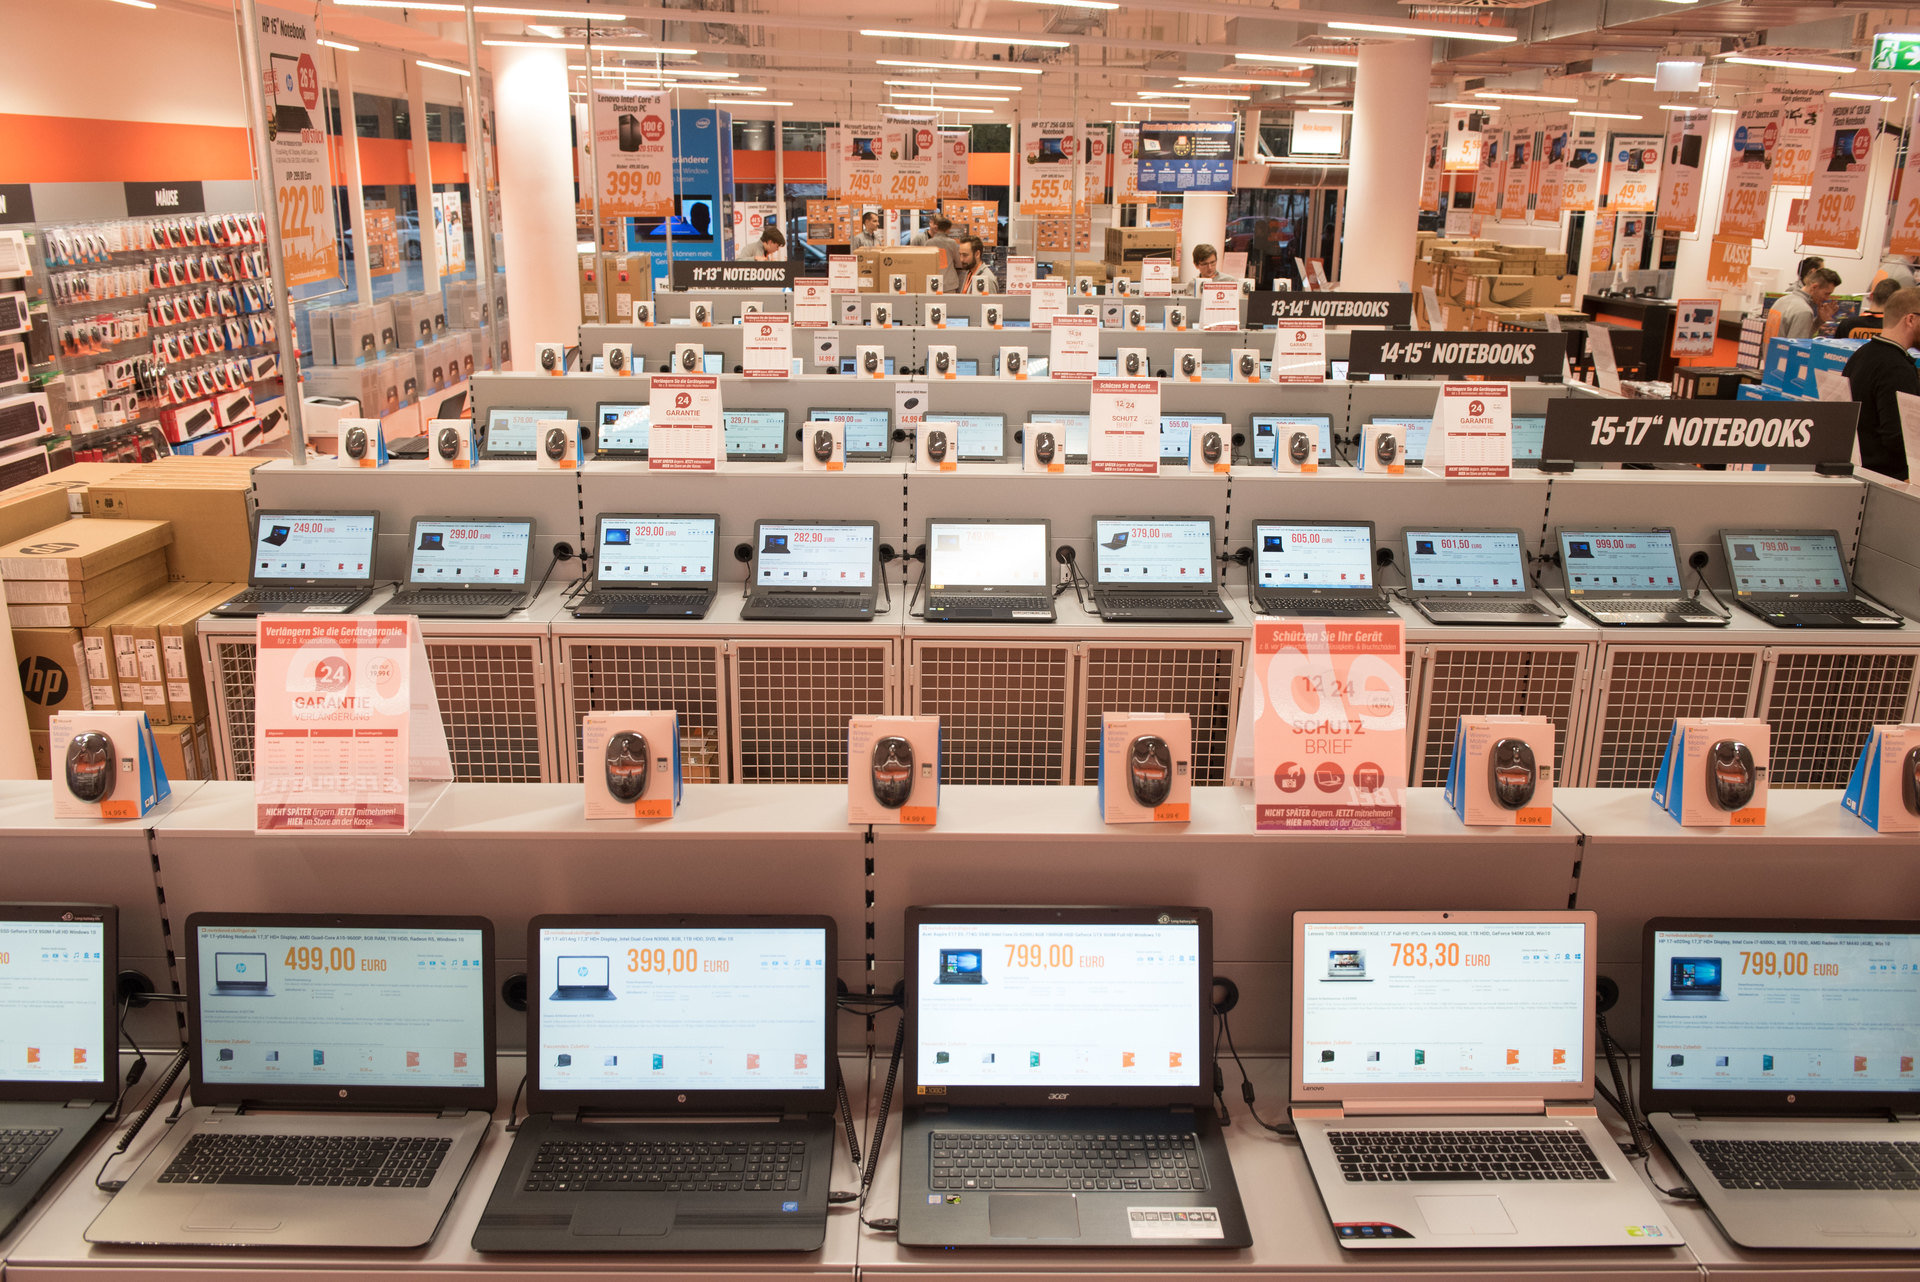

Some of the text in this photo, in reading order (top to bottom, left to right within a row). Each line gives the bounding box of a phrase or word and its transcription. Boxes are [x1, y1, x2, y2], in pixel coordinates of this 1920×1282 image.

[280, 20, 306, 40] Notebook
[598, 94, 620, 103] Lenovo
[613, 104, 647, 112] Desktop PC
[643, 121, 663, 131] 100 €
[1042, 128, 1065, 136] Notebook
[672, 156, 709, 164] eränderer
[155, 189, 179, 207] MÄUSE
[1722, 244, 1750, 264] KASSE
[723, 268, 786, 281] NOTEBOOKS
[1310, 300, 1390, 318] NOTEBOOKS
[1432, 343, 1537, 366] NOTEBOOKS
[677, 396, 689, 404] 24
[1470, 404, 1482, 413] 24
[1663, 417, 1815, 448] NOTEBOOKS
[293, 522, 323, 534] 249,00
[449, 528, 479, 540] 299,00
[635, 526, 664, 537] 329,00
[1131, 527, 1160, 539] 379,00
[794, 532, 823, 543] 282,90
[1291, 533, 1320, 545] 605,00
[1441, 538, 1470, 550] 601,50
[1595, 538, 1624, 550] 999,00
[1760, 541, 1789, 552] 799,00
[266, 626, 402, 638] Verlängern Sie die Gerätegarantie
[1272, 630, 1383, 642] Schützen Sie Ihr Gerät
[320, 665, 346, 683] 24
[1302, 675, 1355, 697] 12 24
[295, 696, 370, 709] GARANTIE
[1292, 719, 1365, 735] SCHUTZ
[1305, 738, 1353, 754] BRIEF
[266, 807, 286, 816] NICHT
[287, 806, 312, 816] SPÄTER
[337, 808, 356, 816] JETZT
[1264, 809, 1285, 817] NICHT
[1285, 807, 1311, 817] SPÄTER
[1335, 809, 1354, 817] JETZT
[287, 817, 303, 826] HIER
[304, 818, 312, 826] im
[313, 817, 331, 826] Store
[339, 817, 352, 826] der
[353, 817, 374, 826] Kasse.
[1285, 818, 1302, 827] HIER
[1302, 819, 1311, 827] im
[1311, 818, 1329, 827] Store
[1338, 818, 1351, 827] der
[284, 946, 387, 974] 499,00 EURO
[627, 948, 730, 975] 399,00 EURO
[1004, 944, 1105, 971] 799,00 EURO
[1391, 943, 1491, 970] 783,30 EURO
[1739, 952, 1839, 979] 799,00 EURO
[1048, 1092, 1070, 1100] acer
